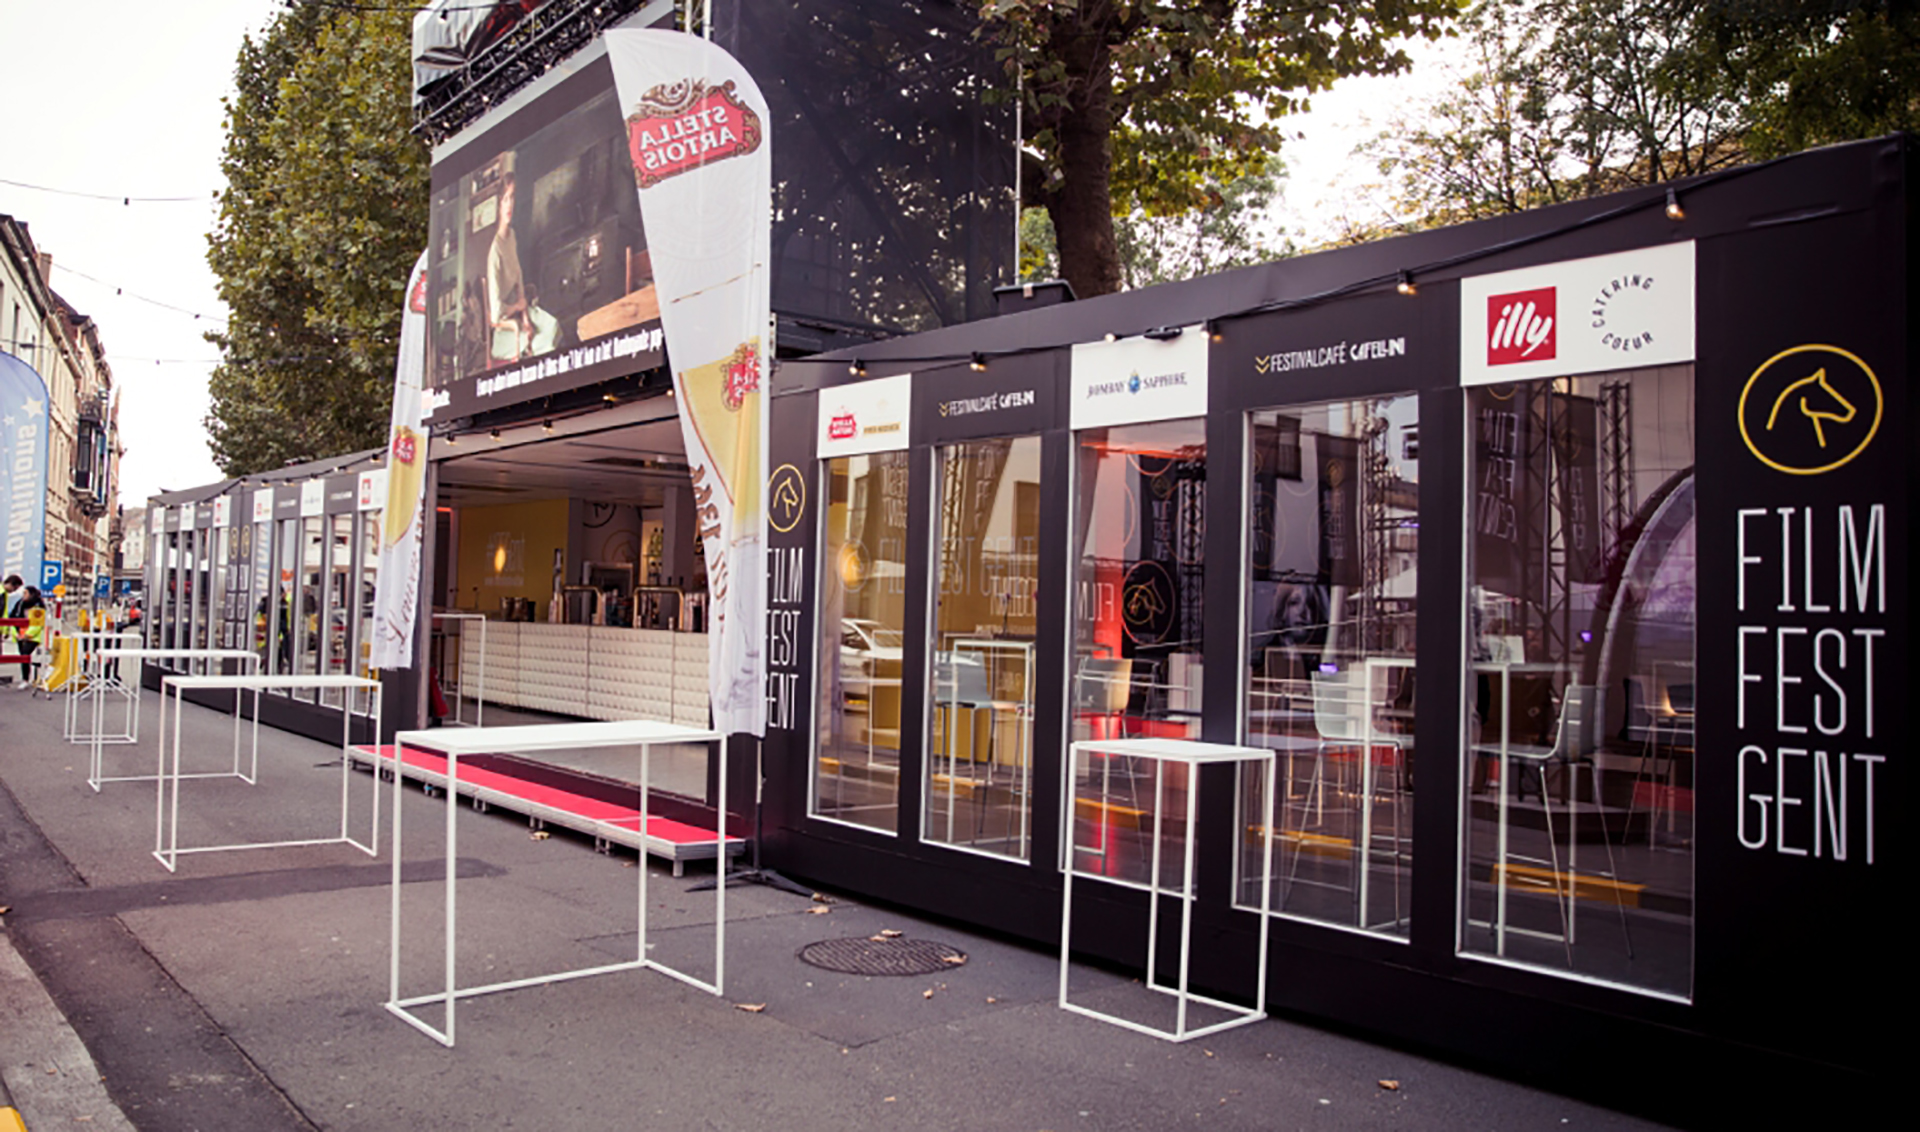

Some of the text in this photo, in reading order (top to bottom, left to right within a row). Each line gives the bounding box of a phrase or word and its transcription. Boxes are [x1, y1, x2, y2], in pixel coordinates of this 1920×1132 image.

[1491, 301, 1553, 357] illy
[1592, 274, 1654, 328] CATERING
[1270, 341, 1347, 372] FESTIVALCAFÉ
[1602, 331, 1654, 351] COEUR
[43, 565, 59, 585] P
[98, 577, 109, 590] P
[1738, 504, 1886, 612] FILM
[766, 610, 801, 667] EST
[765, 671, 799, 730] ENT
[1738, 626, 1886, 738] FEST
[1737, 745, 1887, 864] GENT
